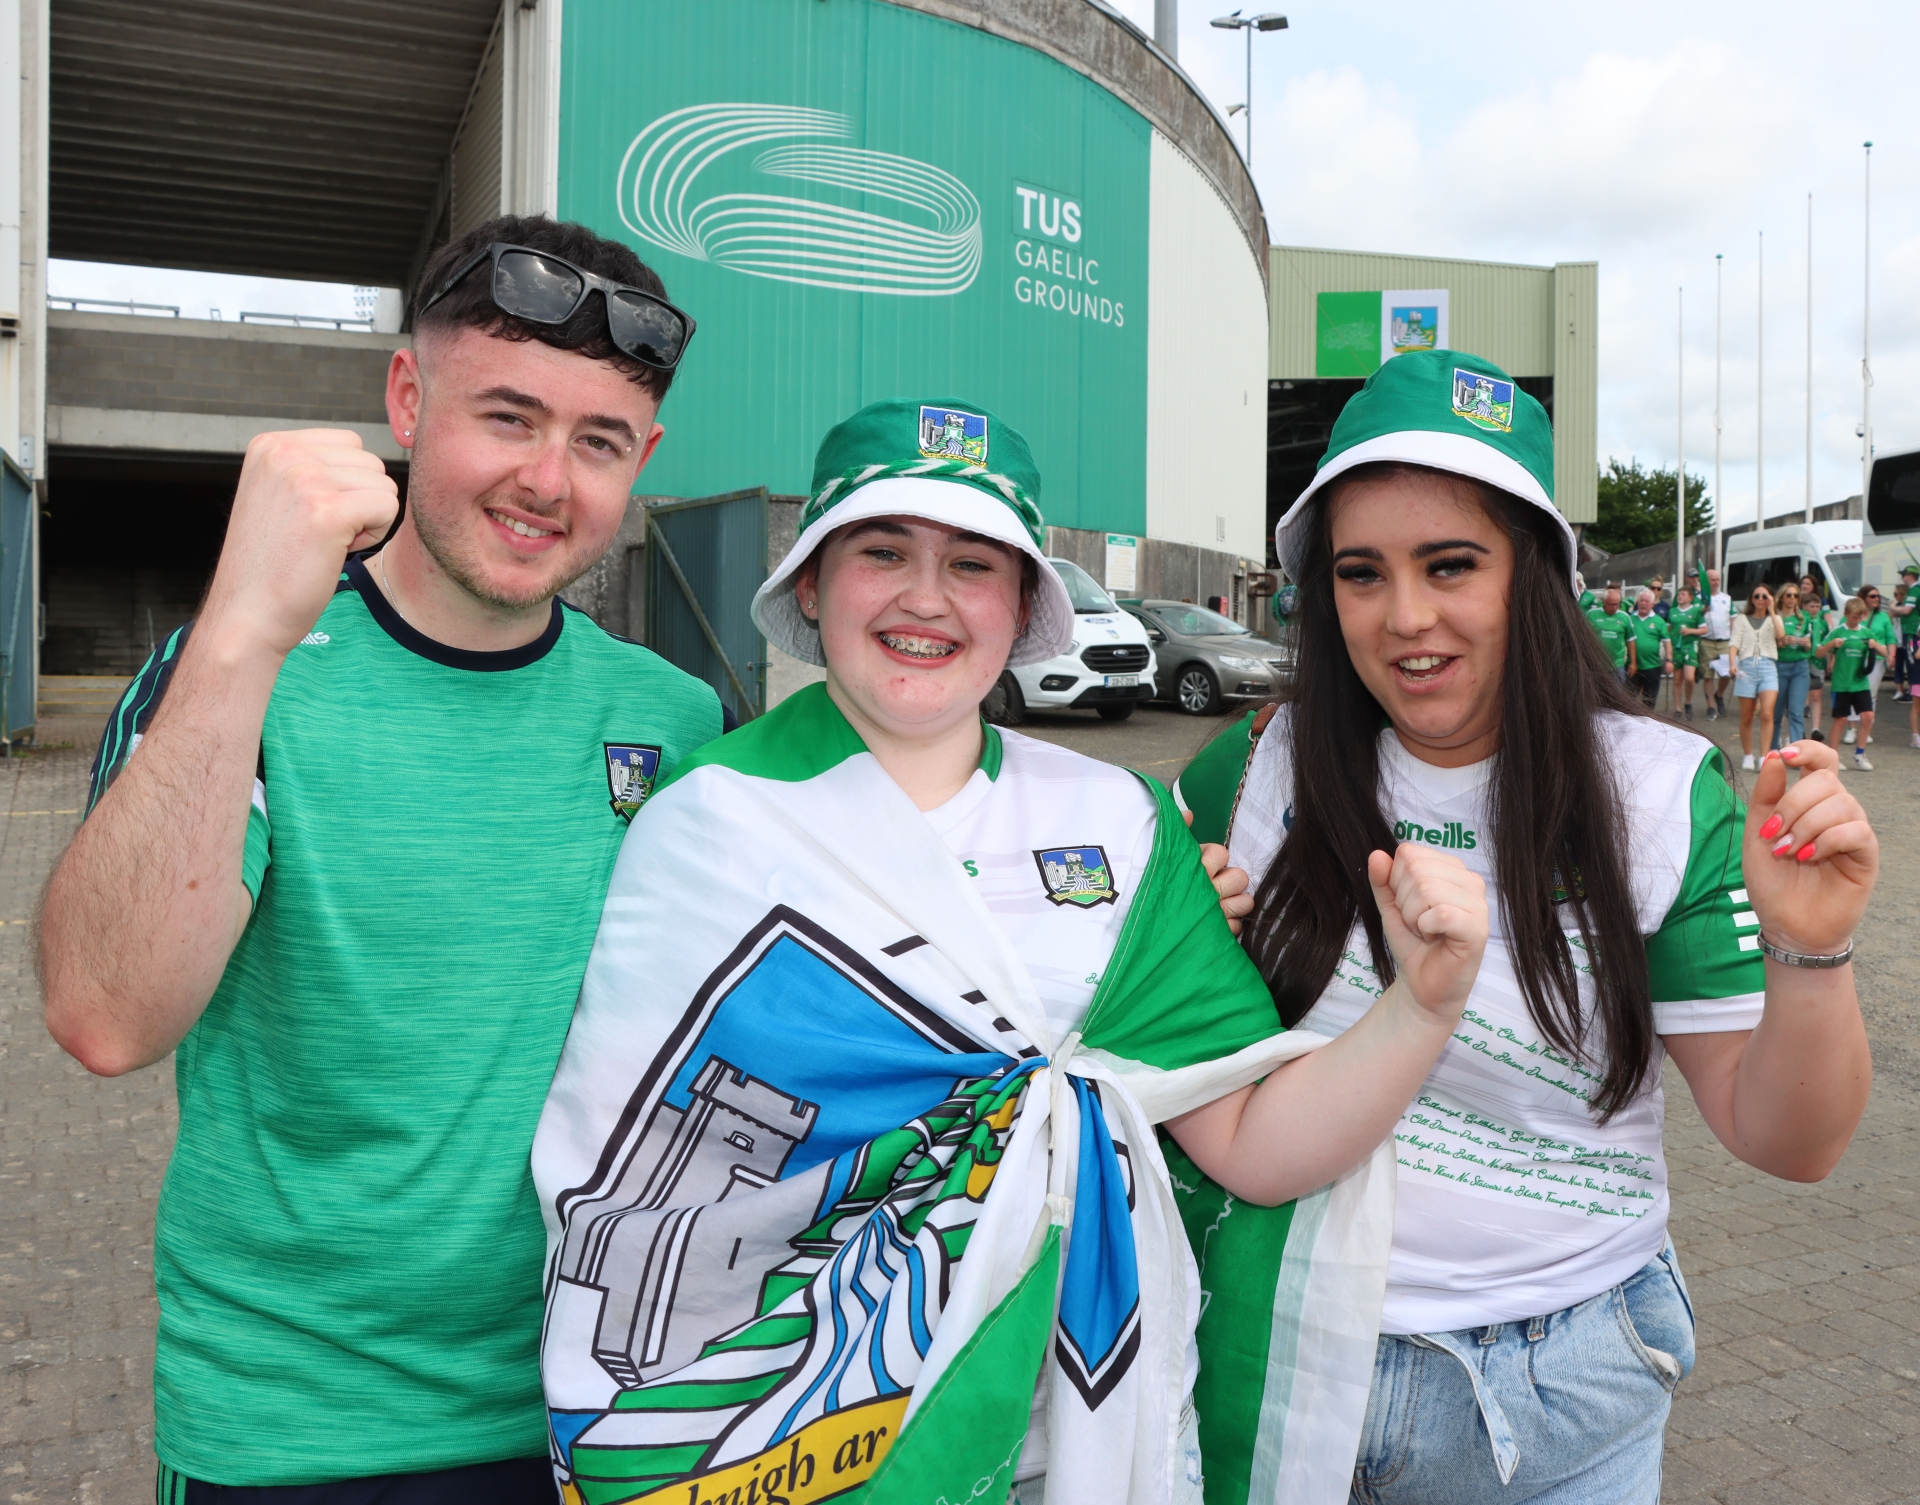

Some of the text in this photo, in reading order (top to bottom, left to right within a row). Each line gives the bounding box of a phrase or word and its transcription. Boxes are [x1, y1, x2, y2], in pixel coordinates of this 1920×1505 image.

[1016, 186, 1082, 243] TUS
[1015, 240, 1099, 285] GAELIC
[1015, 276, 1124, 327] GROUNDS
[832, 1426, 887, 1474] ar
